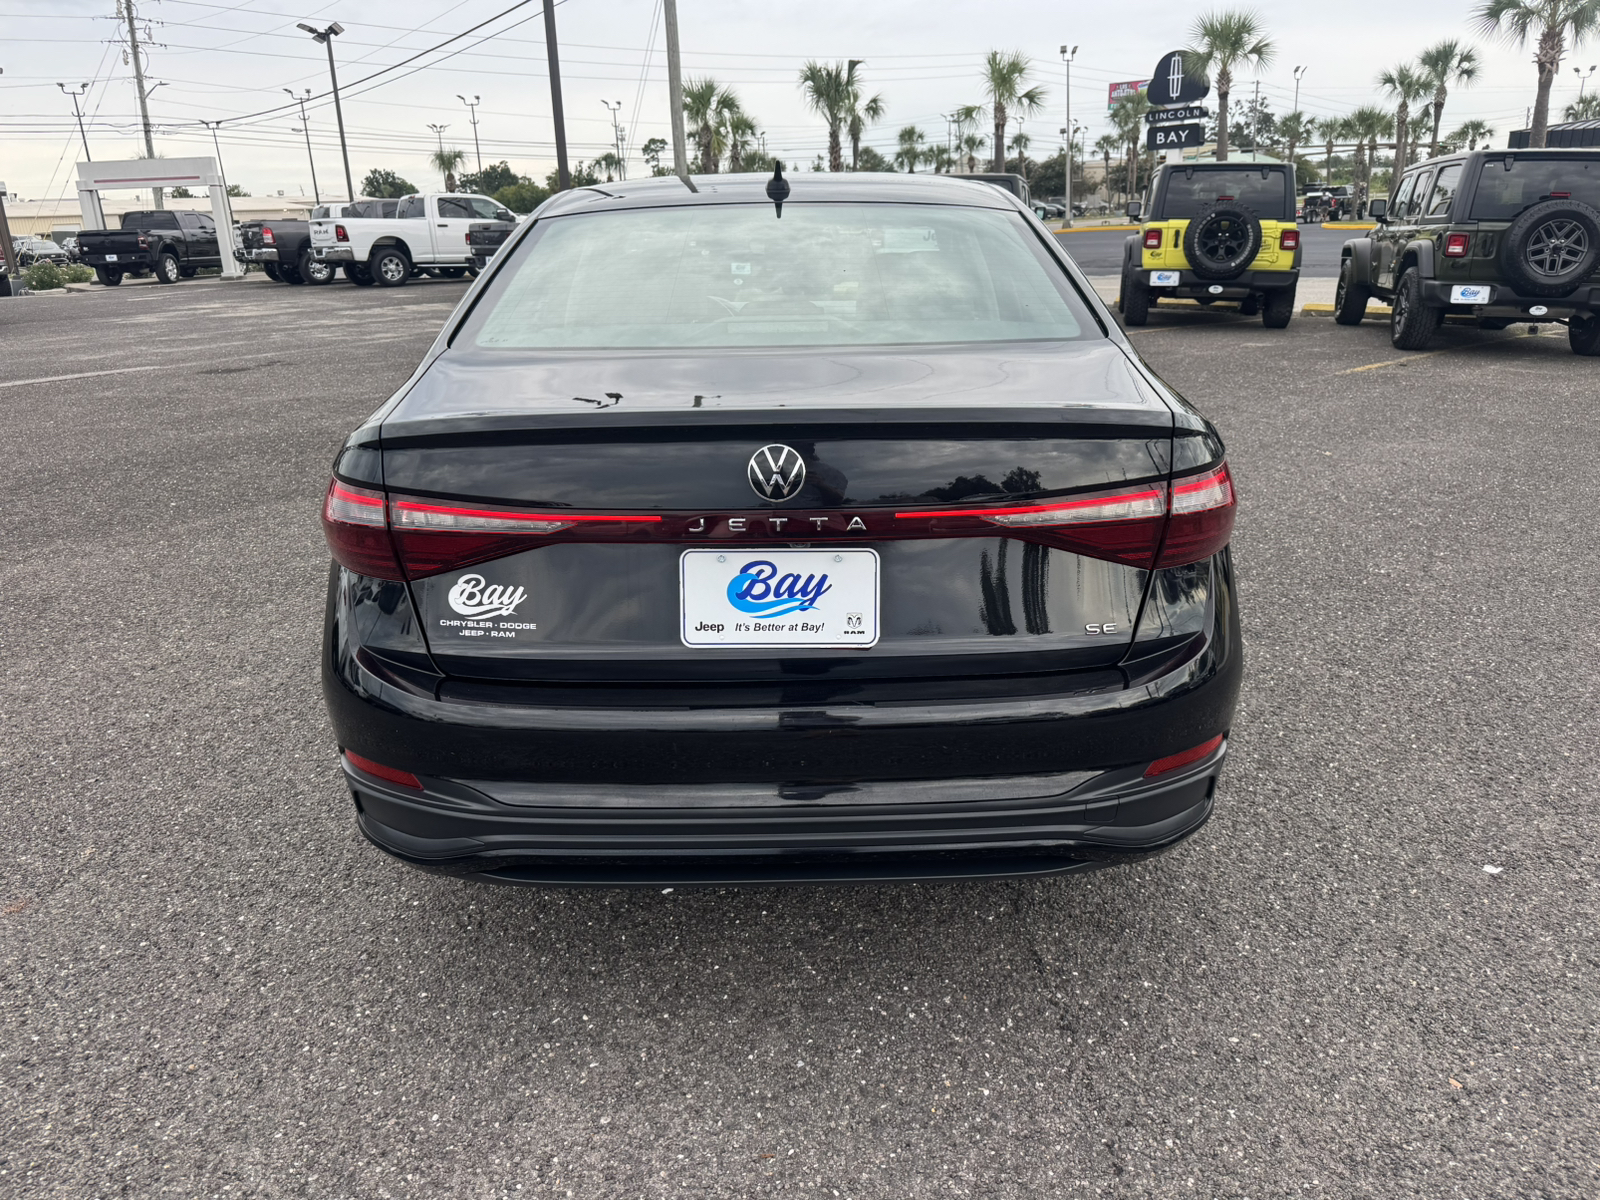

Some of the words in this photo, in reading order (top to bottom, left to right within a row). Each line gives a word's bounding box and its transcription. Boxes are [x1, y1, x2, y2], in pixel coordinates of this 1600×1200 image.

[1148, 109, 1200, 121] LINCOLN
[1156, 129, 1189, 145] BAY
[1460, 287, 1480, 298] Bay
[688, 516, 866, 531] JETTA
[733, 560, 833, 612] Bay
[450, 573, 527, 618] Bay
[440, 620, 493, 628] CHRYSLER
[499, 622, 537, 630] DODGE
[695, 621, 725, 633] Jeep
[735, 622, 751, 632] It's
[753, 622, 785, 632] Better
[788, 623, 798, 632] at
[801, 622, 825, 633] Bay!
[1085, 623, 1117, 635] SE
[459, 629, 485, 637] JEEP
[490, 630, 516, 638] RAM
